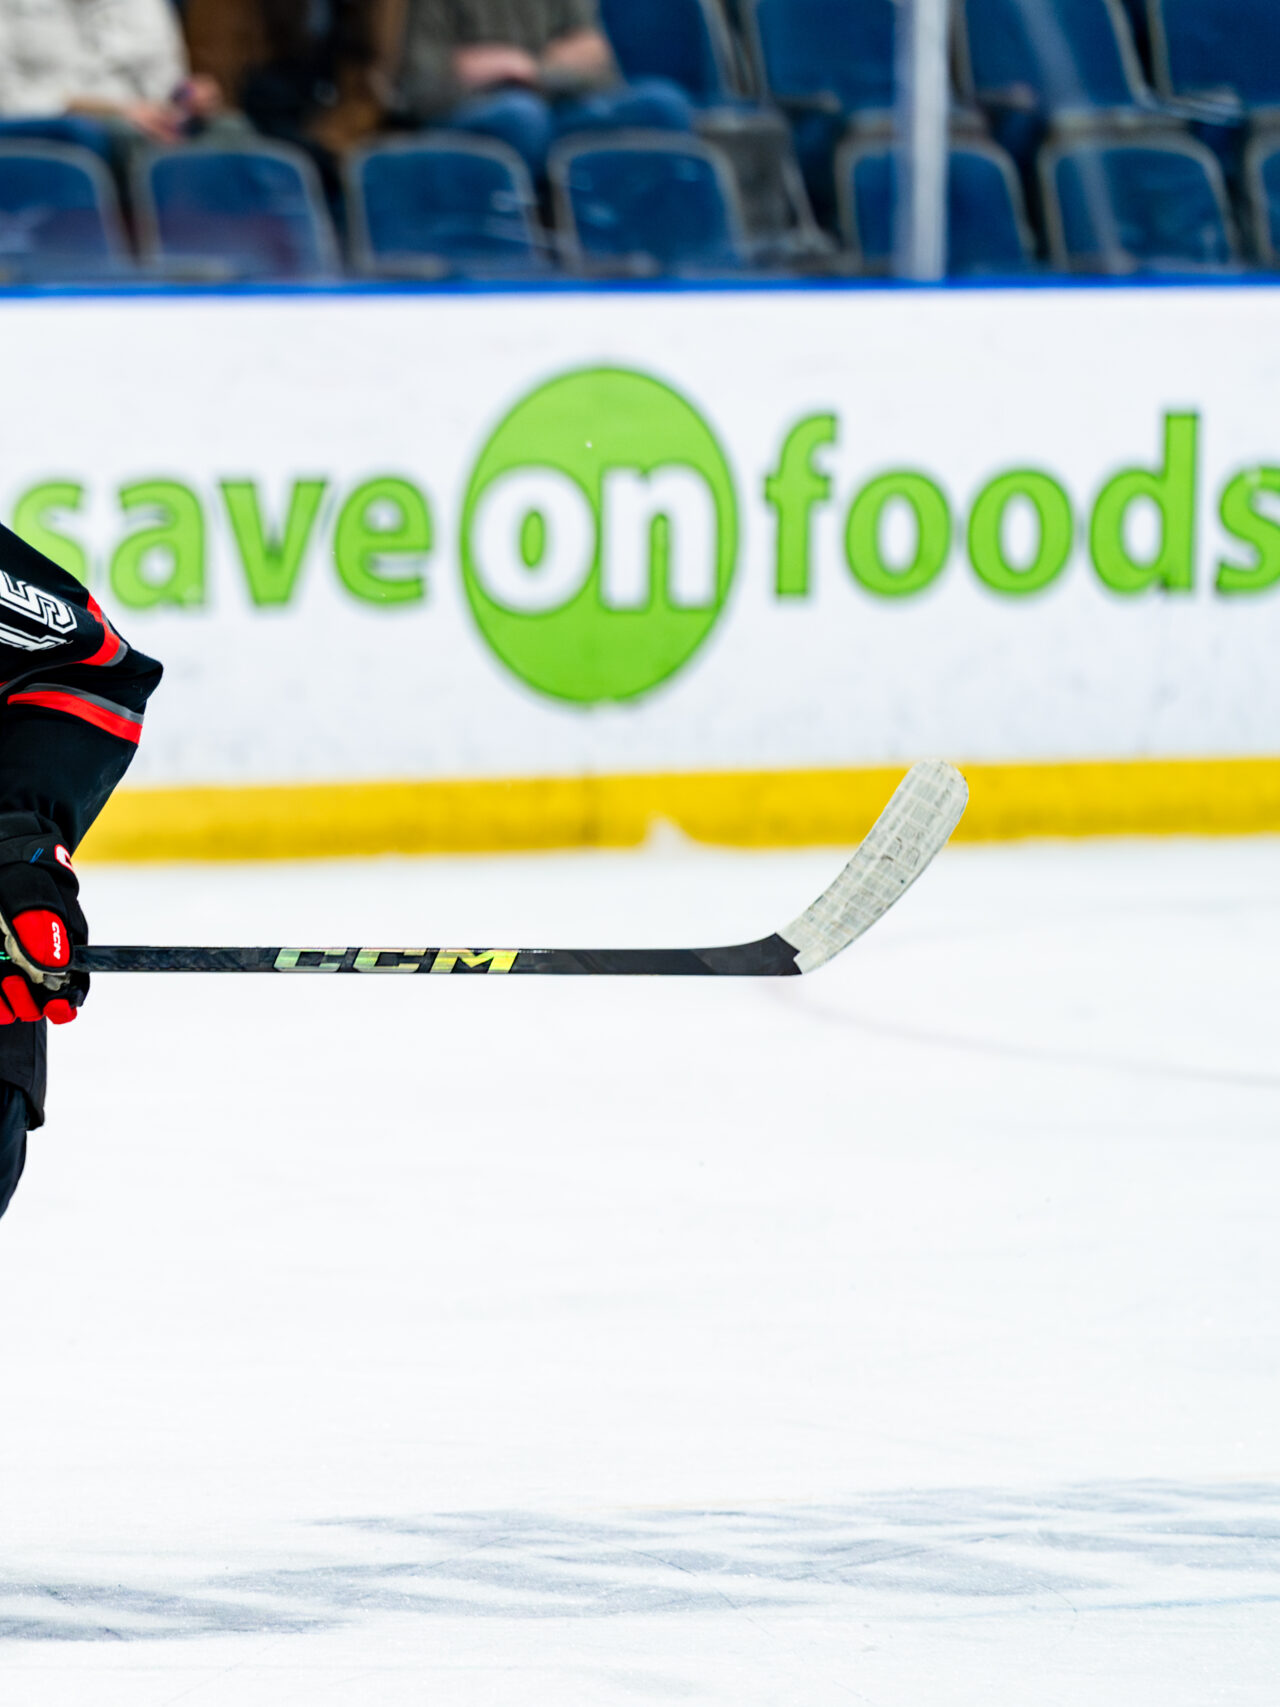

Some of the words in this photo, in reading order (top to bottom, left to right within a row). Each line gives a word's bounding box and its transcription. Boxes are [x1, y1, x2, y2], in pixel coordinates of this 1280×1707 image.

[13, 476, 433, 612] save
[469, 461, 717, 612] on
[763, 410, 1280, 597] foods
[51, 921, 61, 960] CCM
[273, 948, 519, 974] CCM
